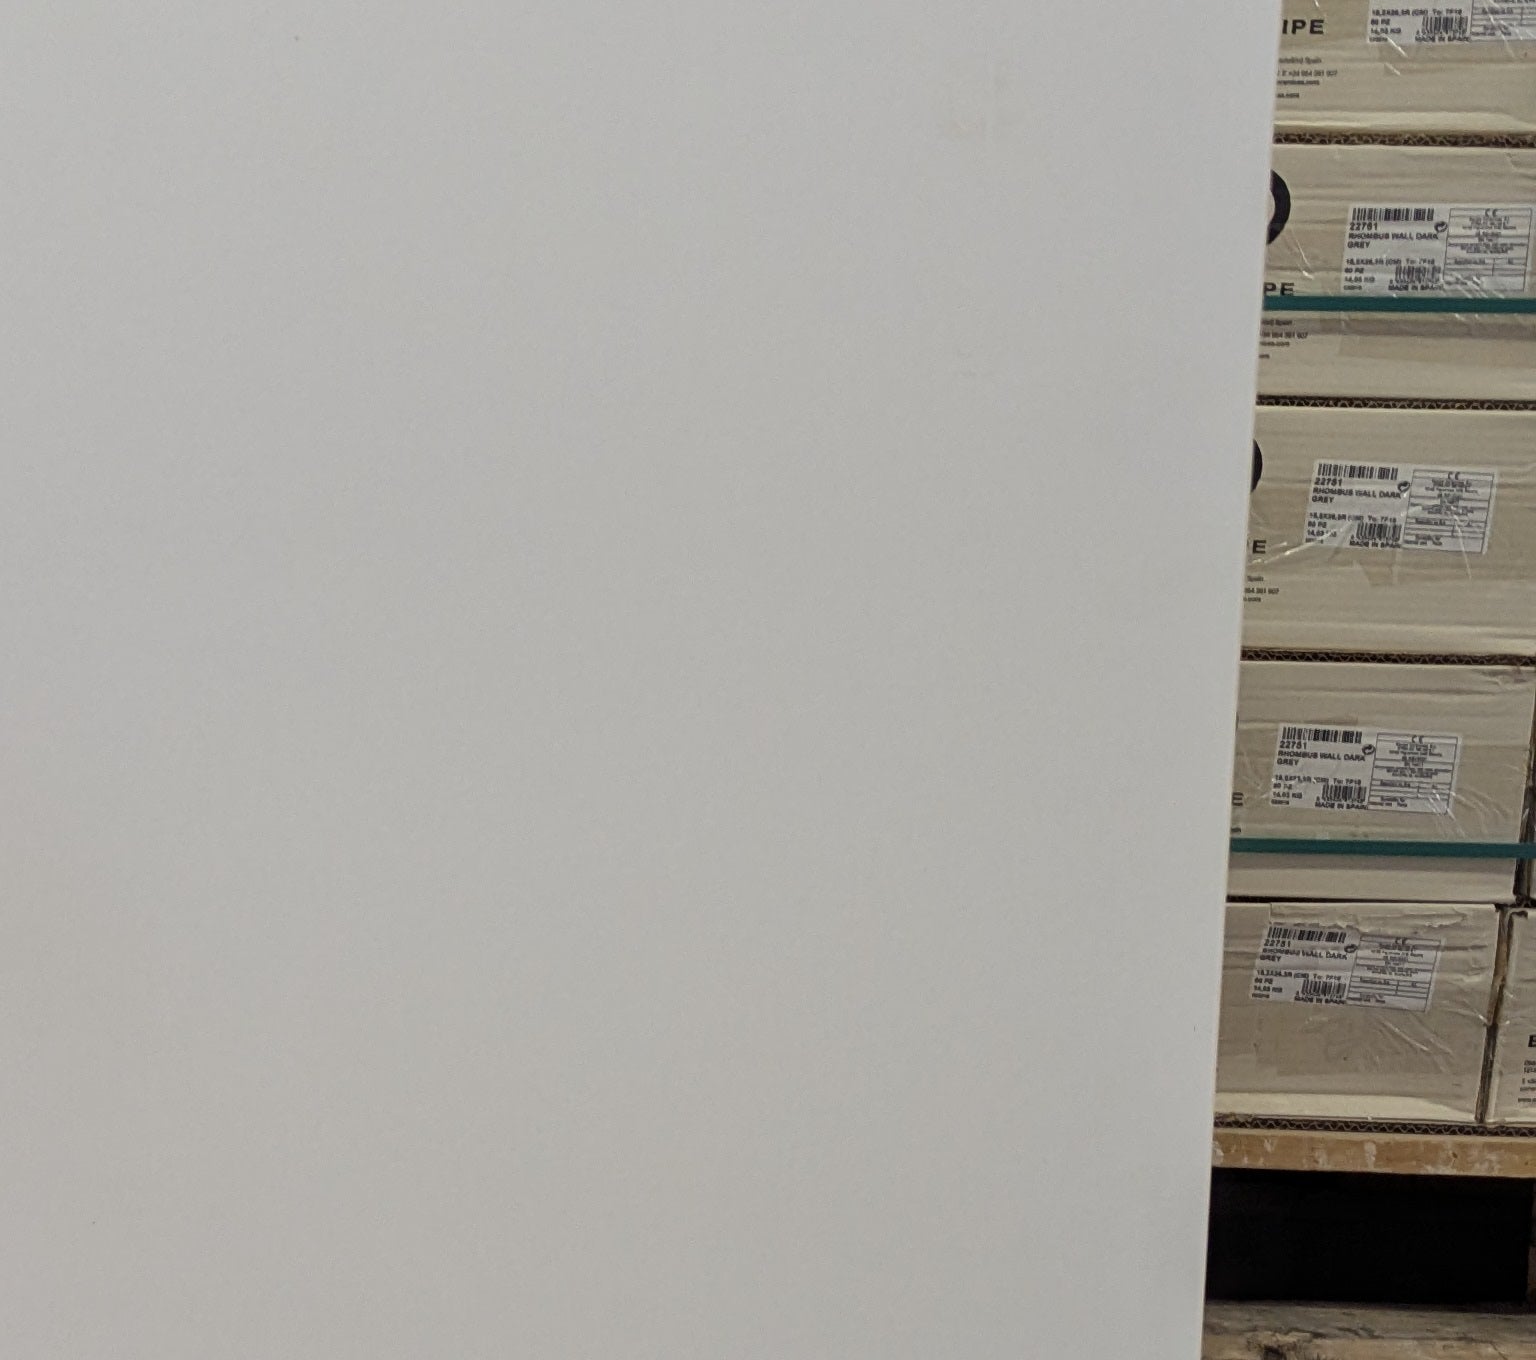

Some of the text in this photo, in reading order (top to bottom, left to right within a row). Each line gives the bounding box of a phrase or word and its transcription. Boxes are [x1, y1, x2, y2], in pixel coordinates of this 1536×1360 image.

[1282, 19, 1325, 35] IPE
[1391, 232, 1414, 240] WALL
[1347, 241, 1371, 249] GREY
[1311, 496, 1335, 504] GREY
[1319, 752, 1342, 761] WALL
[1276, 758, 1300, 766] GREY
[1259, 954, 1282, 962] GREY
[1325, 951, 1348, 960] DARK
